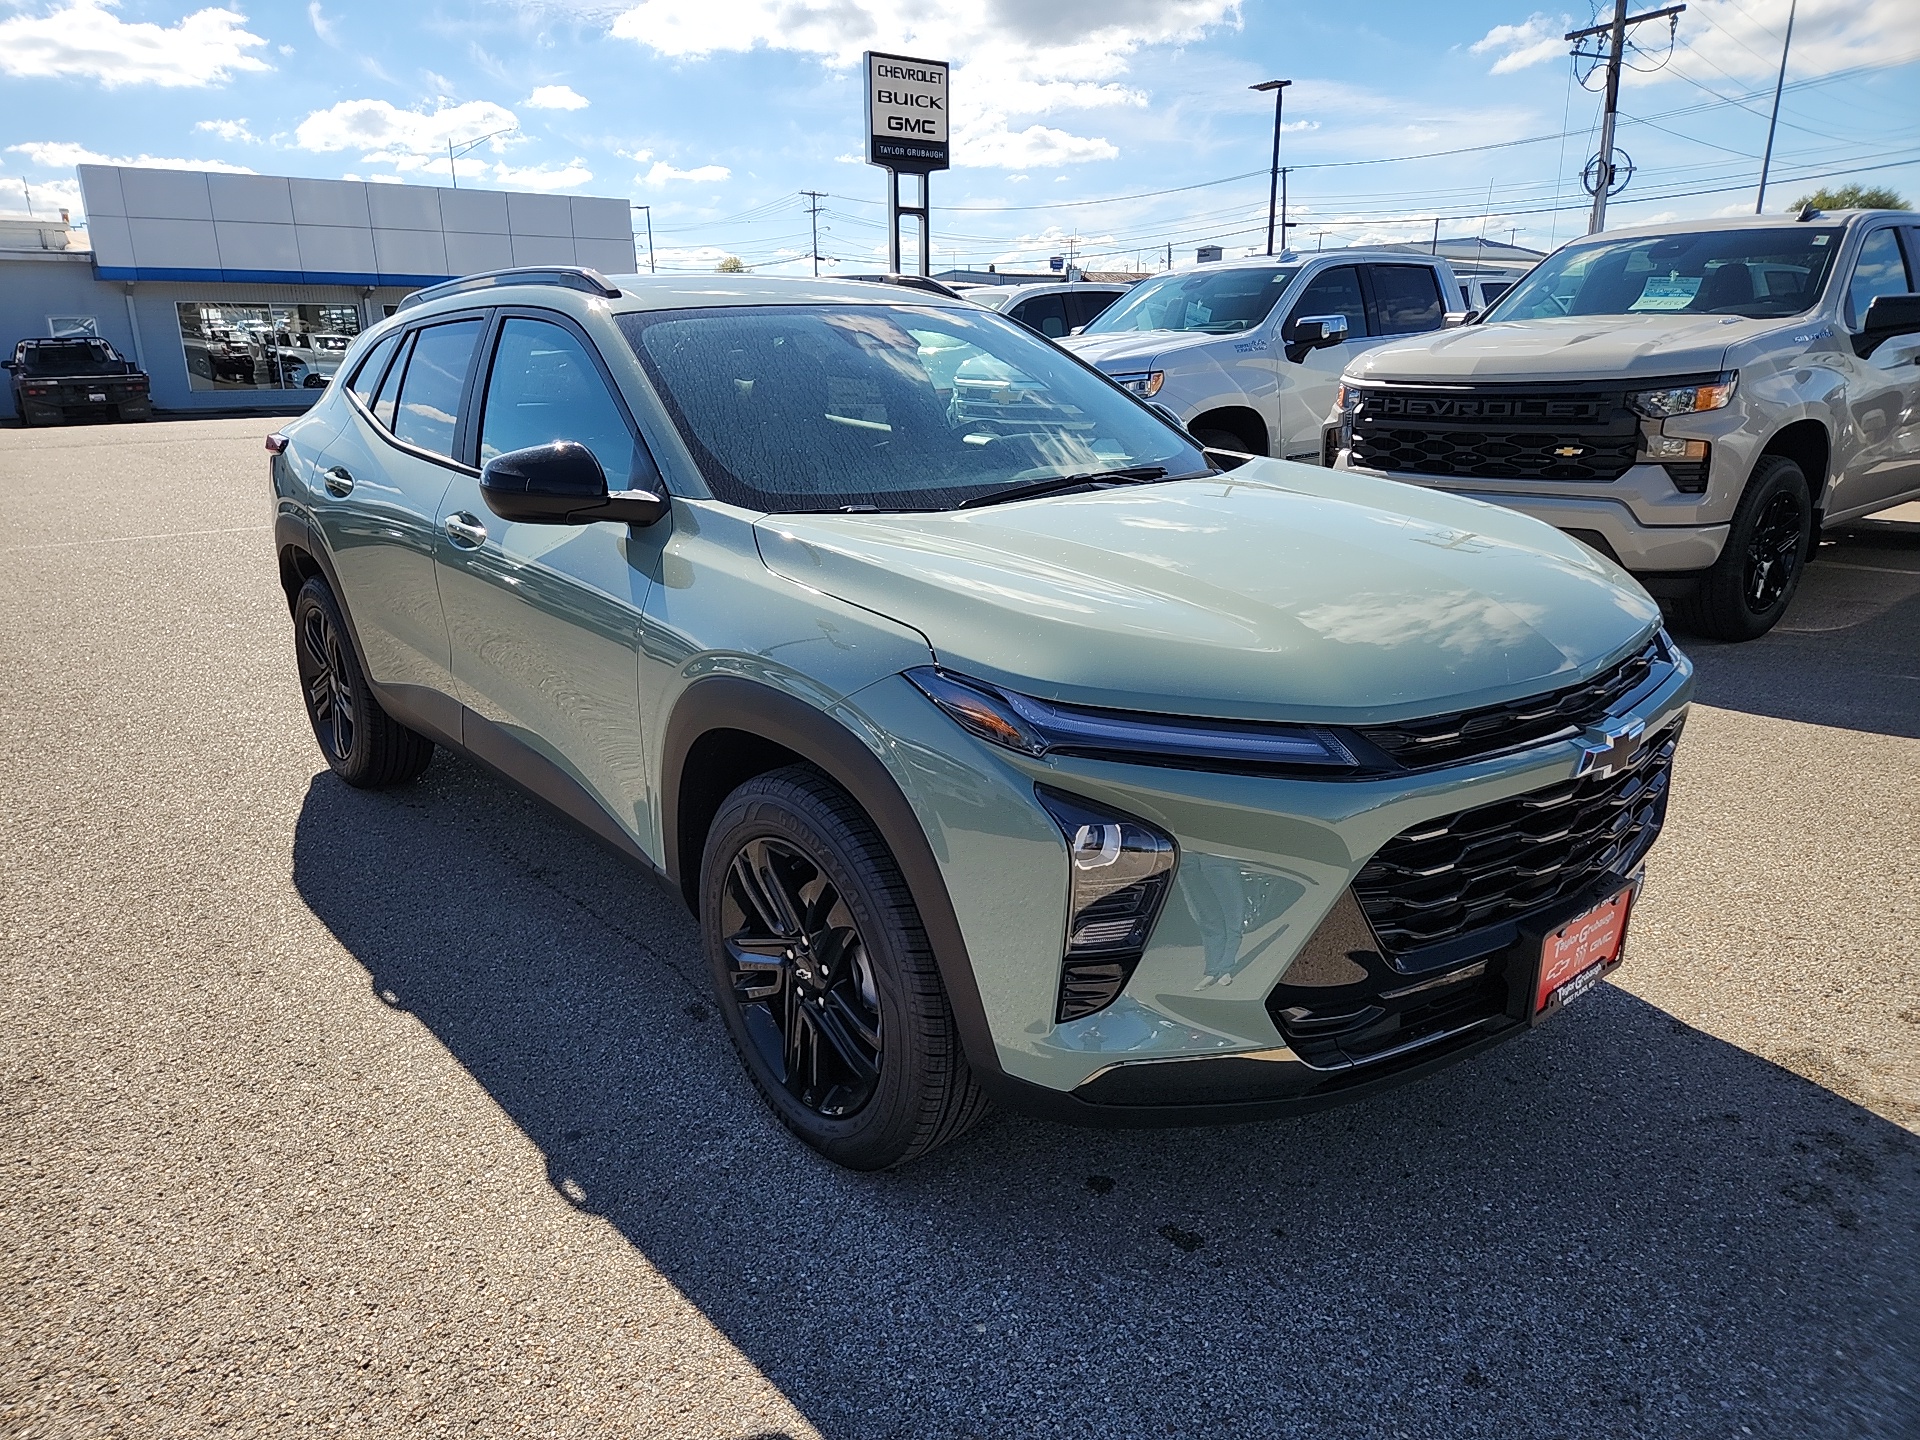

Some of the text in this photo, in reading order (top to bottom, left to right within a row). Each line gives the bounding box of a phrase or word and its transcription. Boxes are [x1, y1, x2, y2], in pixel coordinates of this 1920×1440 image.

[878, 64, 943, 84] CHEVROLET
[877, 89, 944, 110] BUICK
[887, 115, 936, 134] GMC
[880, 145, 944, 159] TAYLOR GRUBAUGH
[1363, 397, 1610, 418] CHEVROLET
[778, 809, 871, 923] GOODYEAR
[1554, 911, 1615, 958] Taylor Grubaugh
[1589, 930, 1613, 952] GMC
